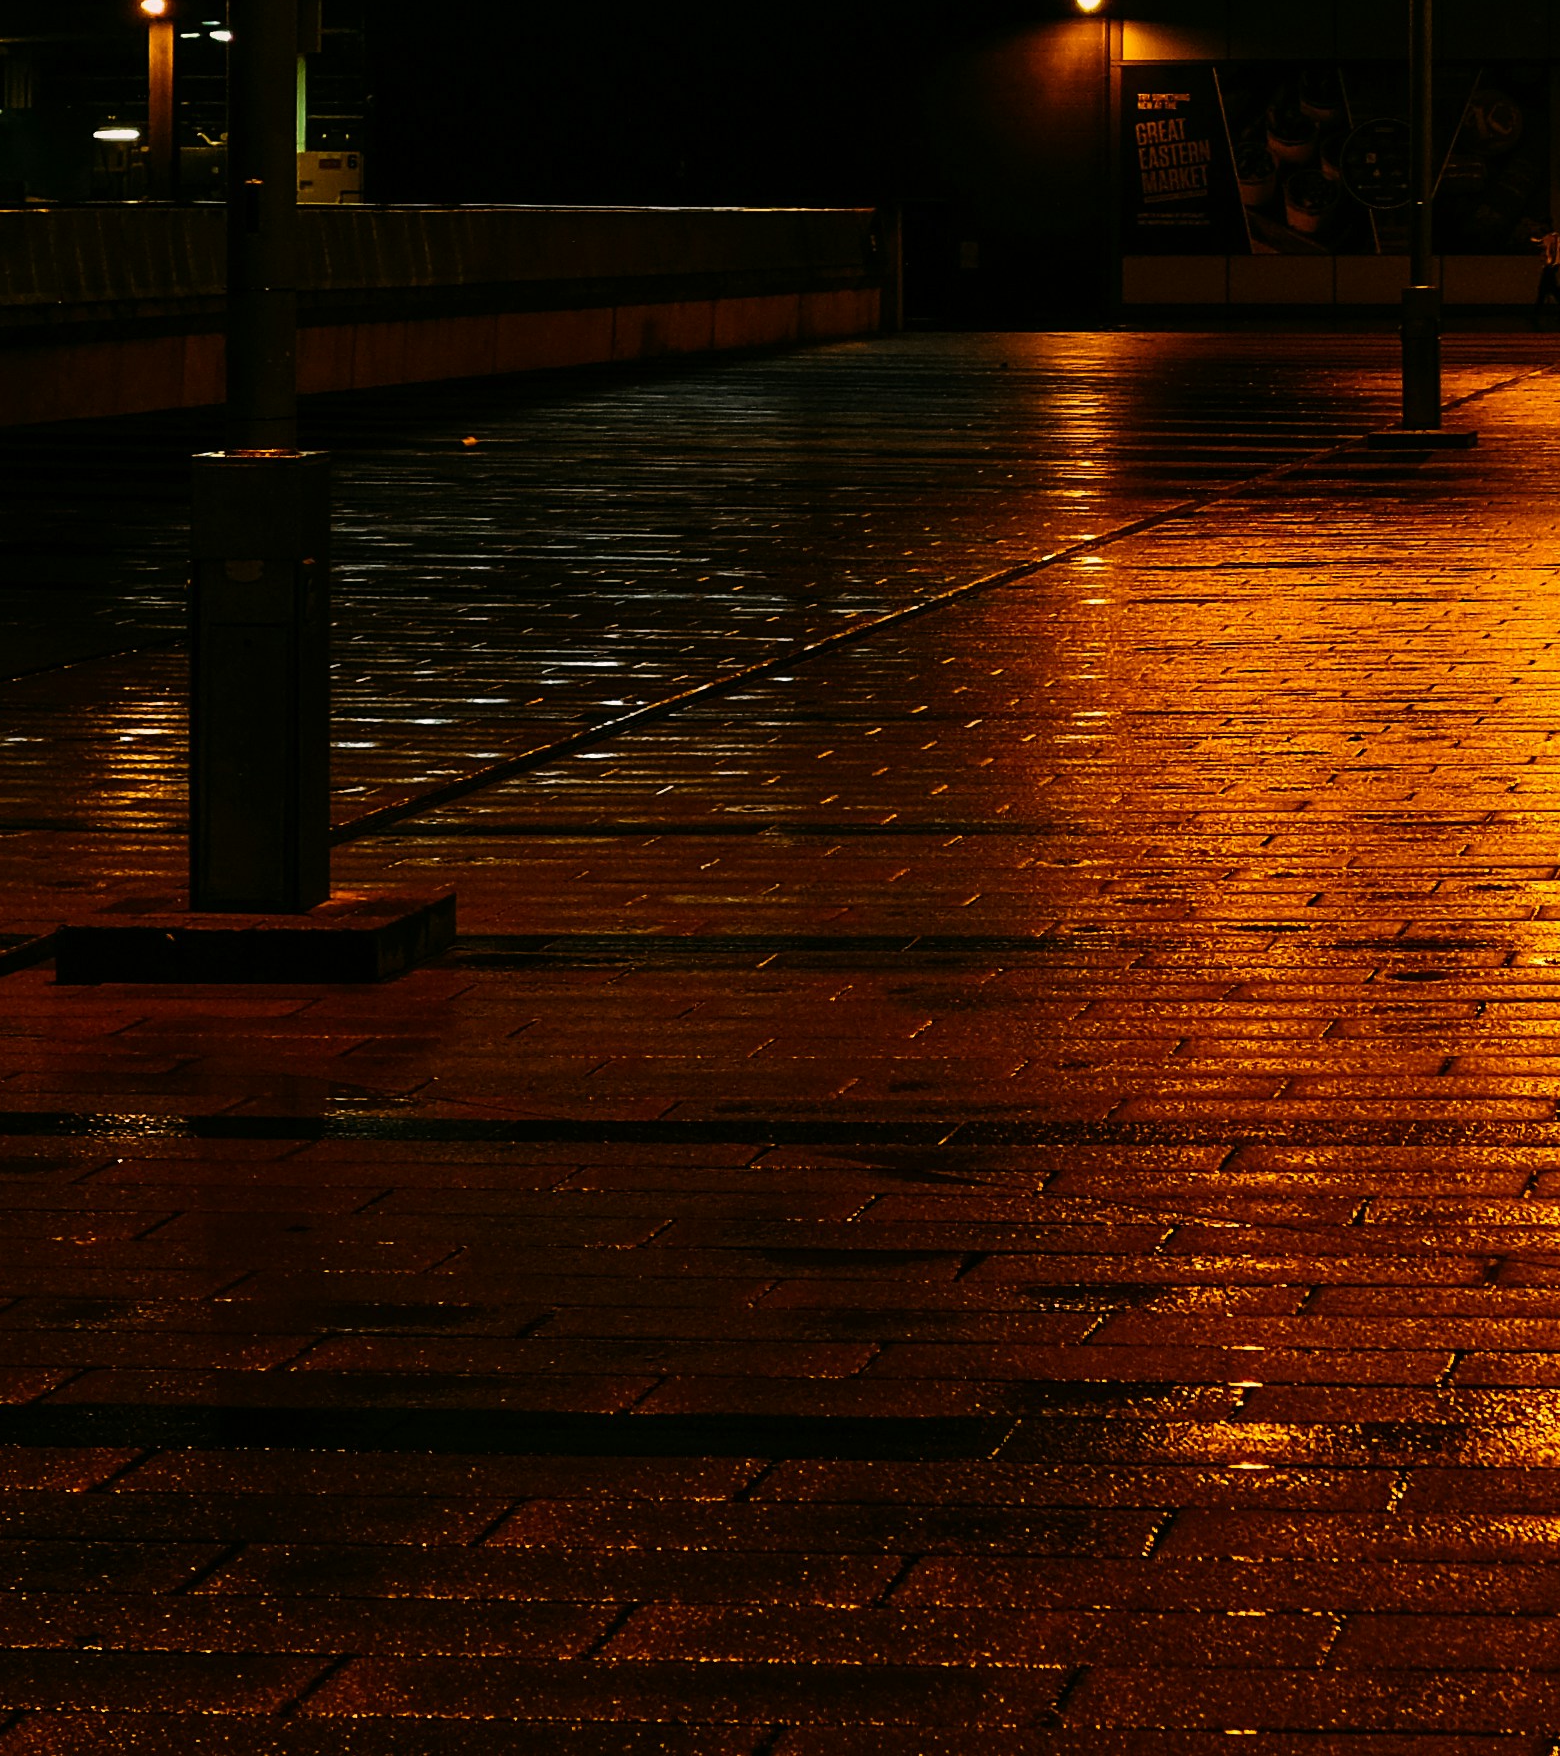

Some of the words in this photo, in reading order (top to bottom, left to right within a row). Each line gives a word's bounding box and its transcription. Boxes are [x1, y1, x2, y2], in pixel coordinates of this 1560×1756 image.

[1135, 117, 1186, 146] GREAT
[1138, 139, 1212, 171] EASTERN
[1142, 163, 1208, 194] MARKET
